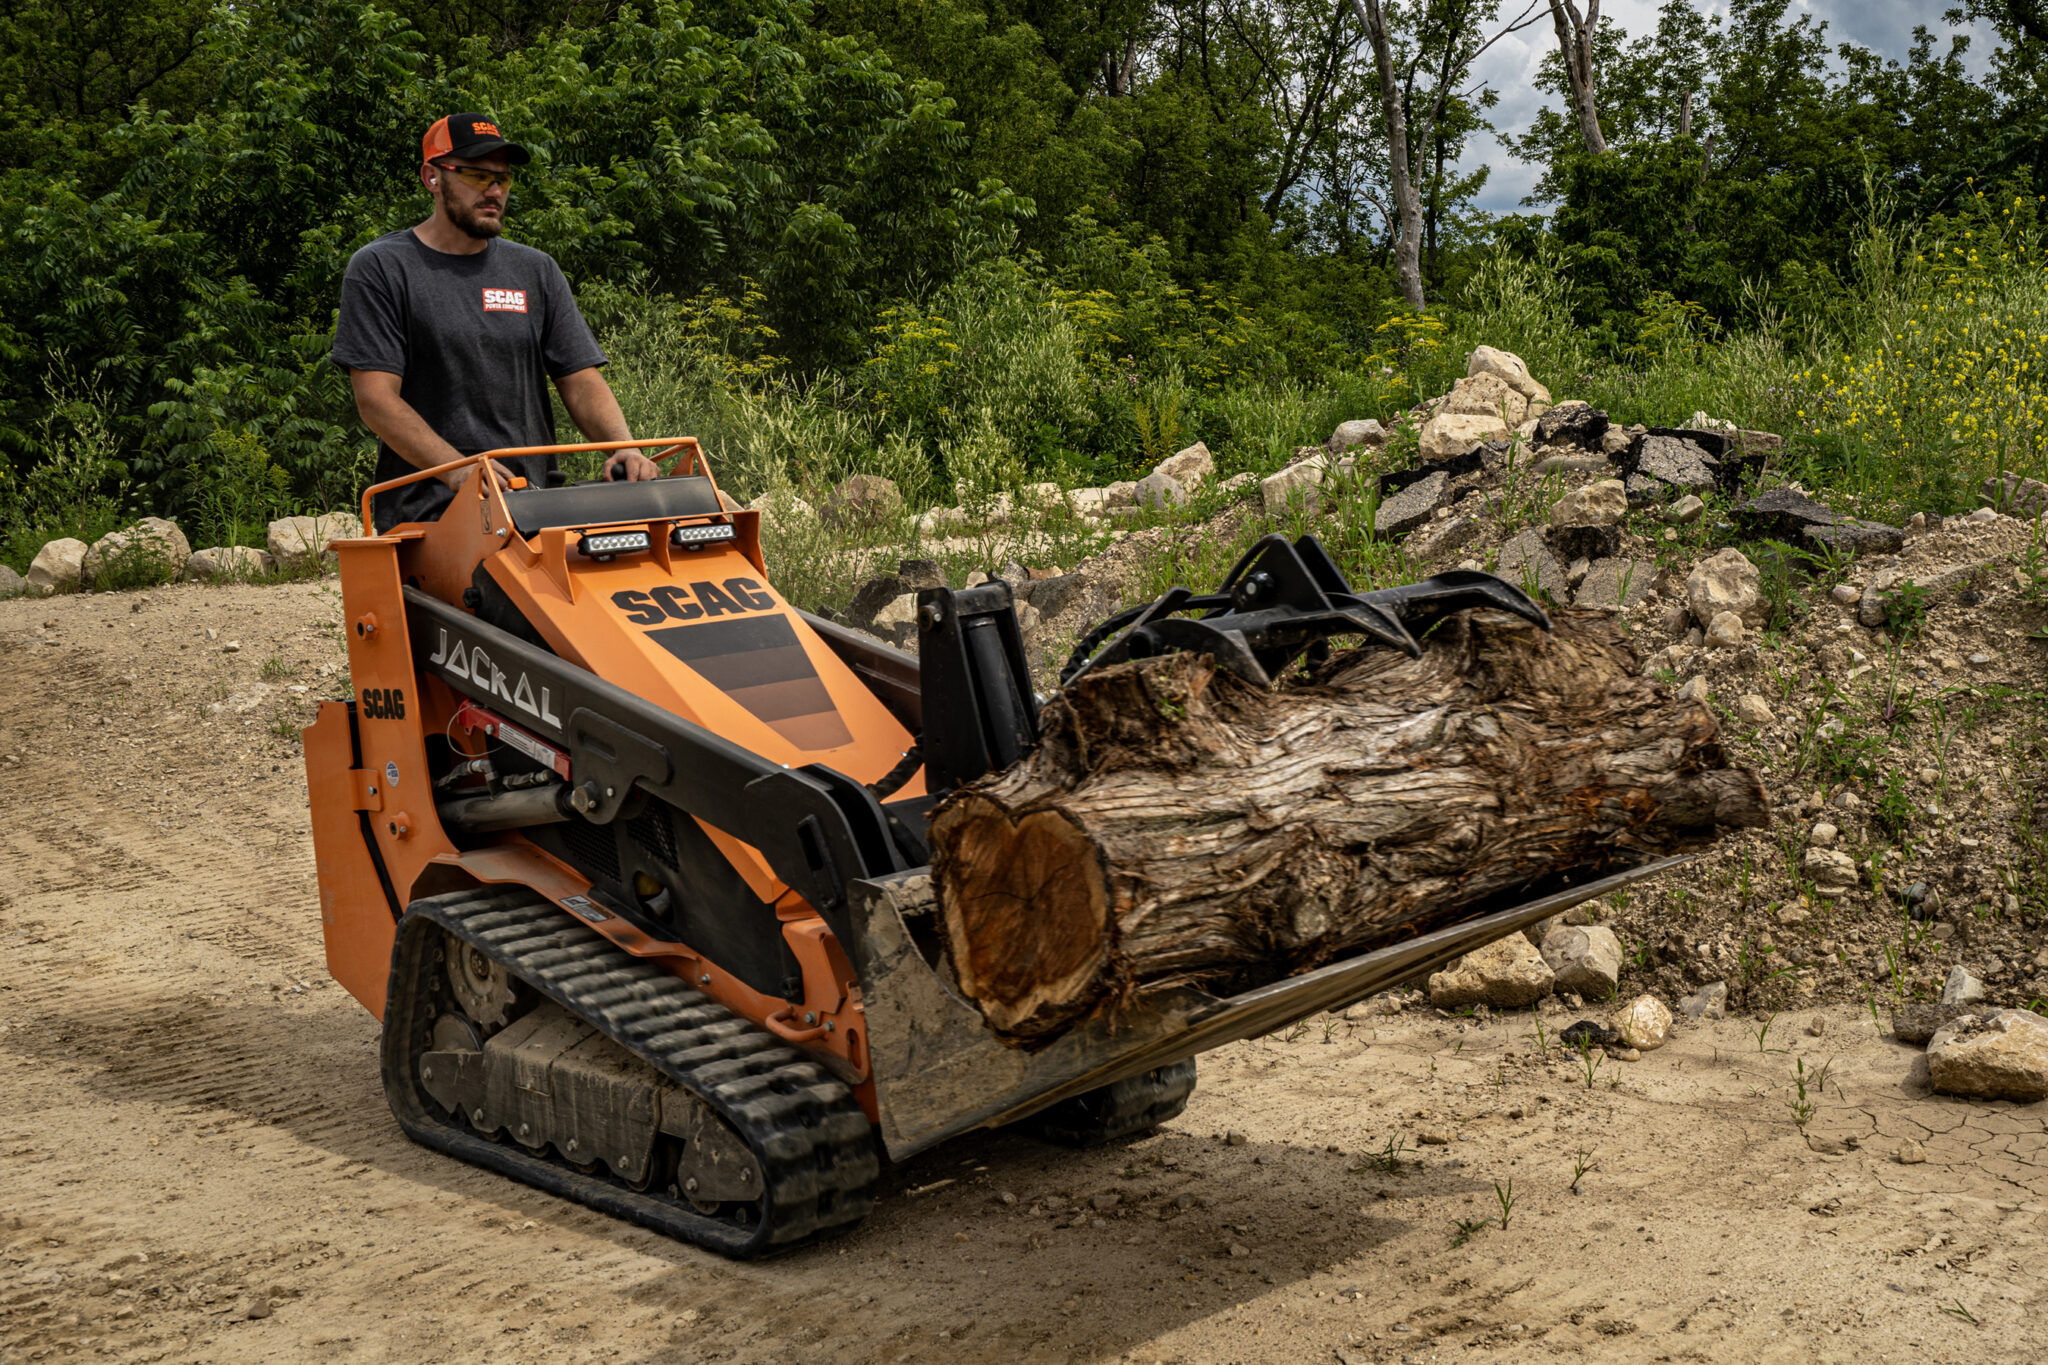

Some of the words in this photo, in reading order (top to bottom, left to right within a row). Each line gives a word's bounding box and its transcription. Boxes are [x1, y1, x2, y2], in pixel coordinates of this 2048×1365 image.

[484, 290, 525, 305] SCAG
[610, 577, 776, 625] SCAG
[362, 688, 405, 720] SCAG
